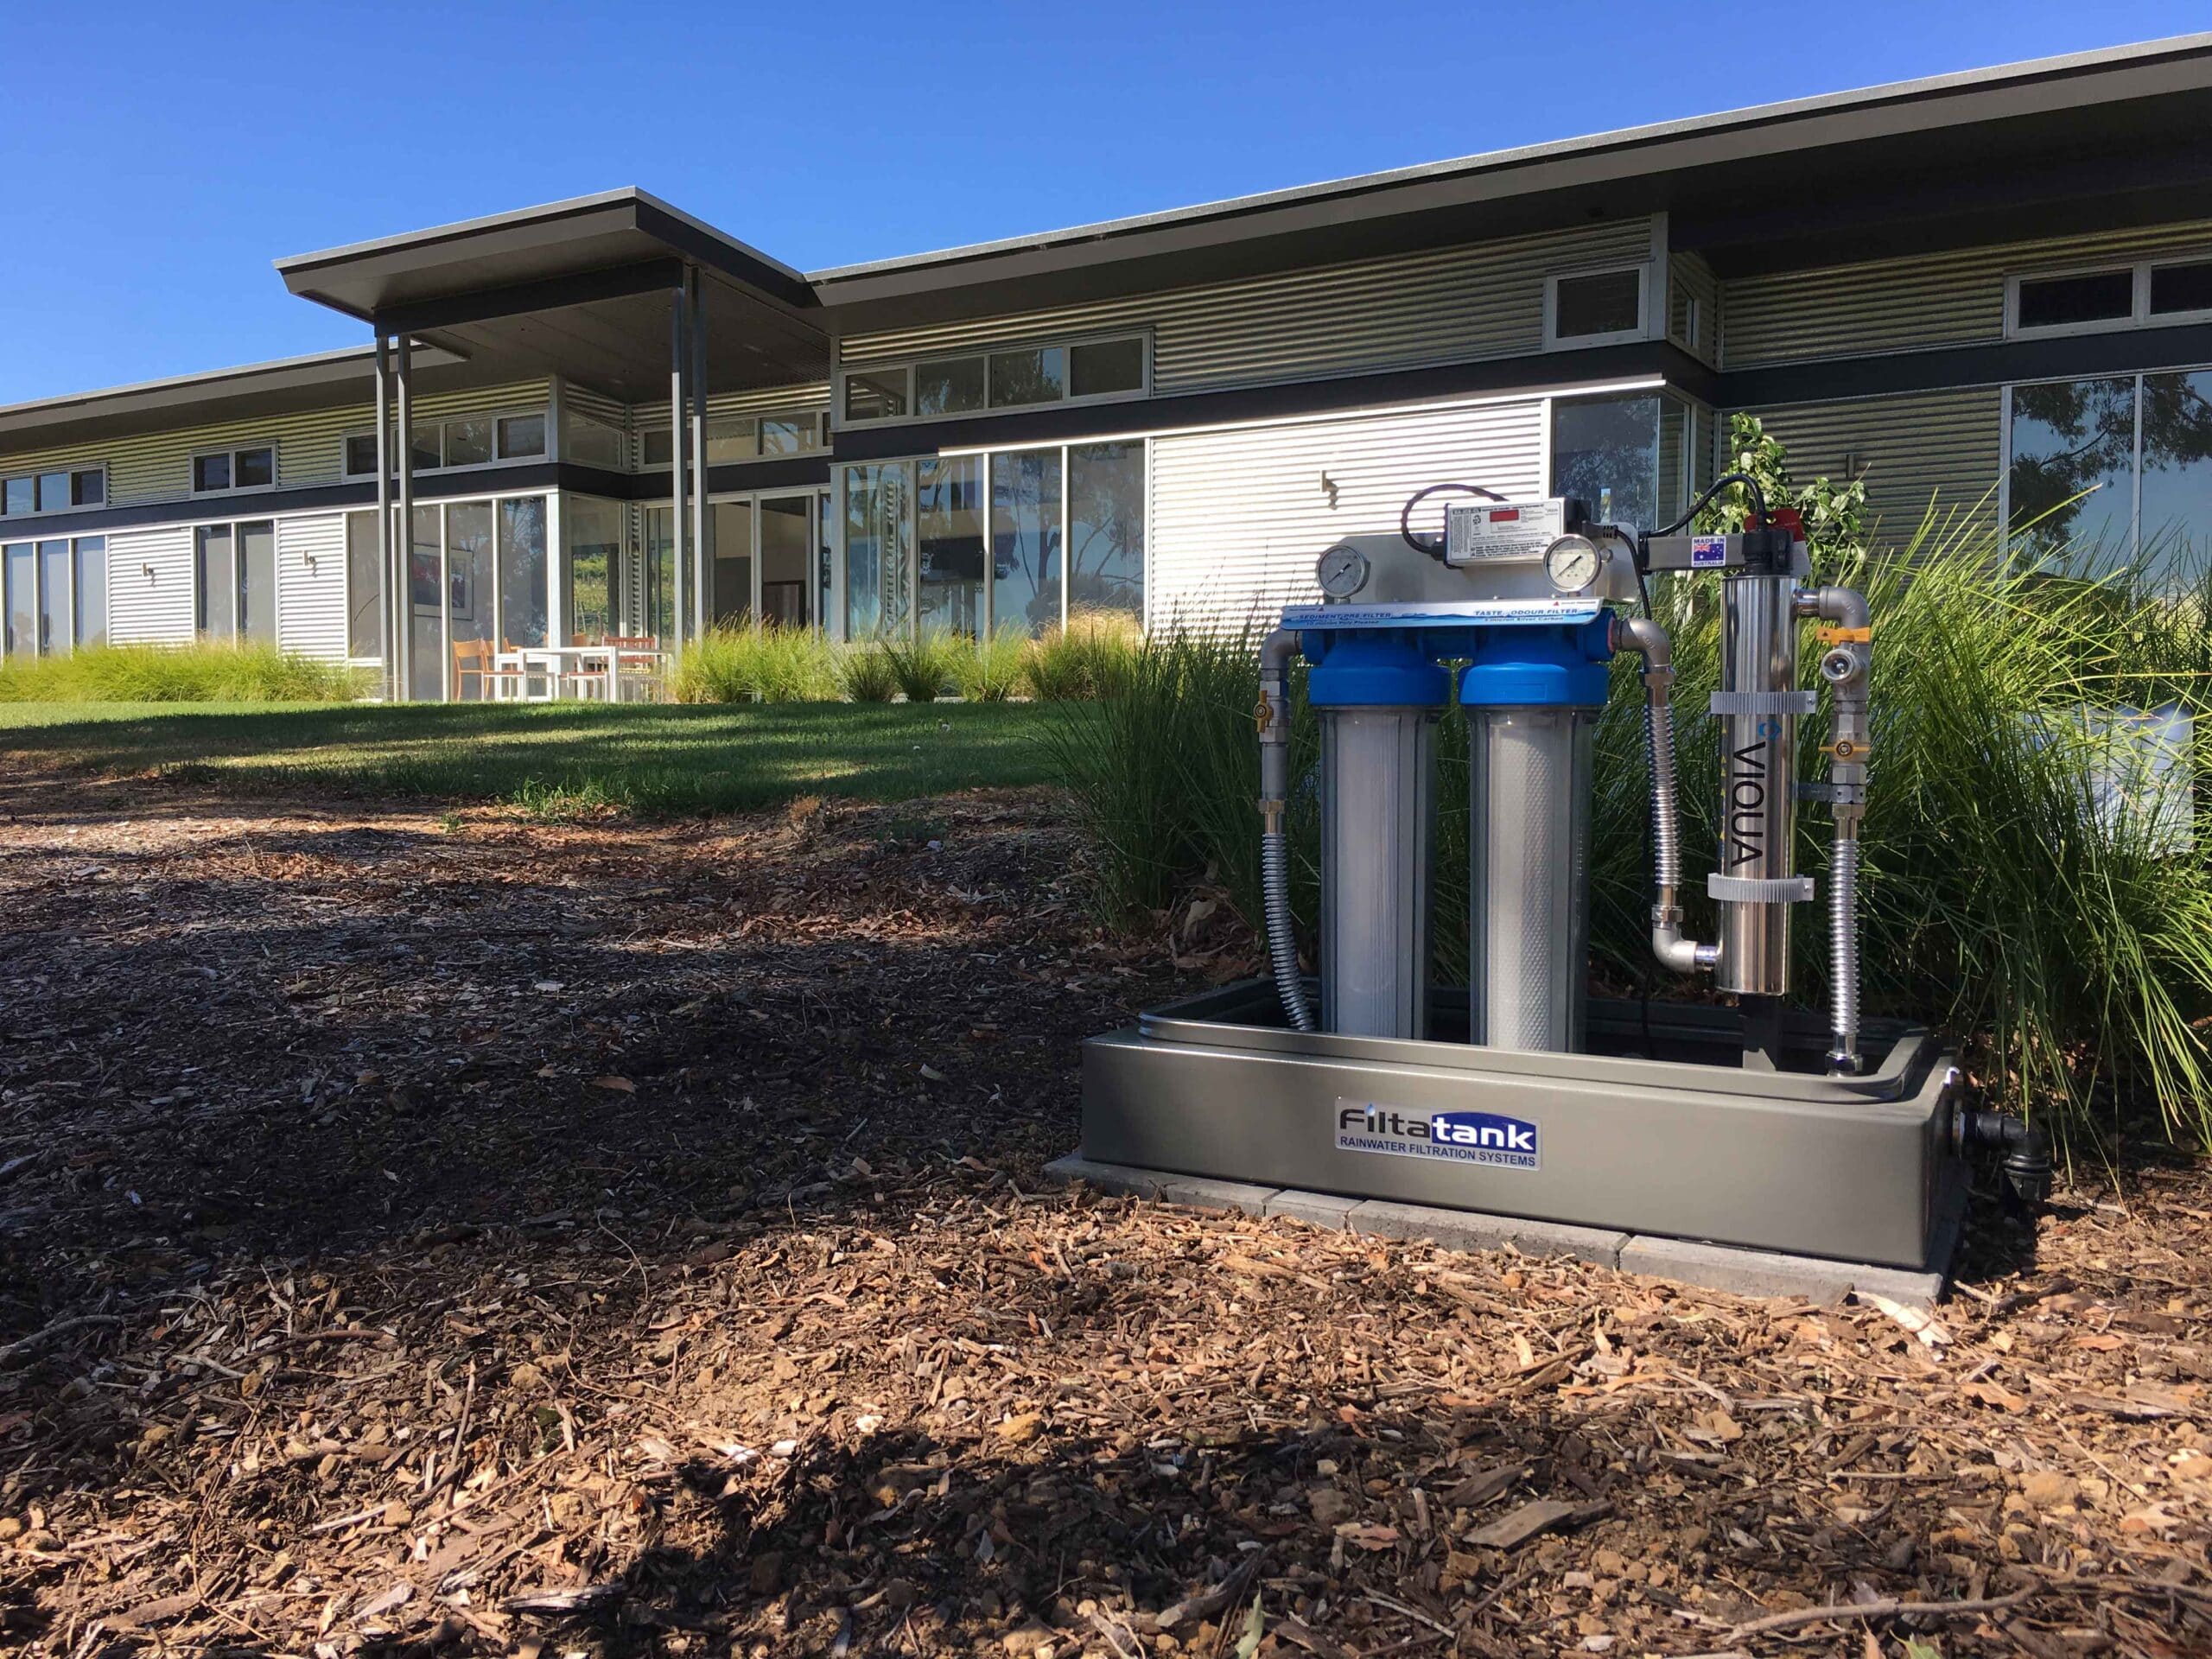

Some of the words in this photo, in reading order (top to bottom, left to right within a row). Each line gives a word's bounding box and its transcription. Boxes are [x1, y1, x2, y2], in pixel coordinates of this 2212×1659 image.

[1731, 741, 1766, 868] VIQUA
[1340, 1103, 1535, 1151] Filtatank
[1340, 1136, 1406, 1153] RAINWATER
[1409, 1143, 1475, 1160] FILTRATION
[1479, 1152, 1535, 1166] SYSTEMS
